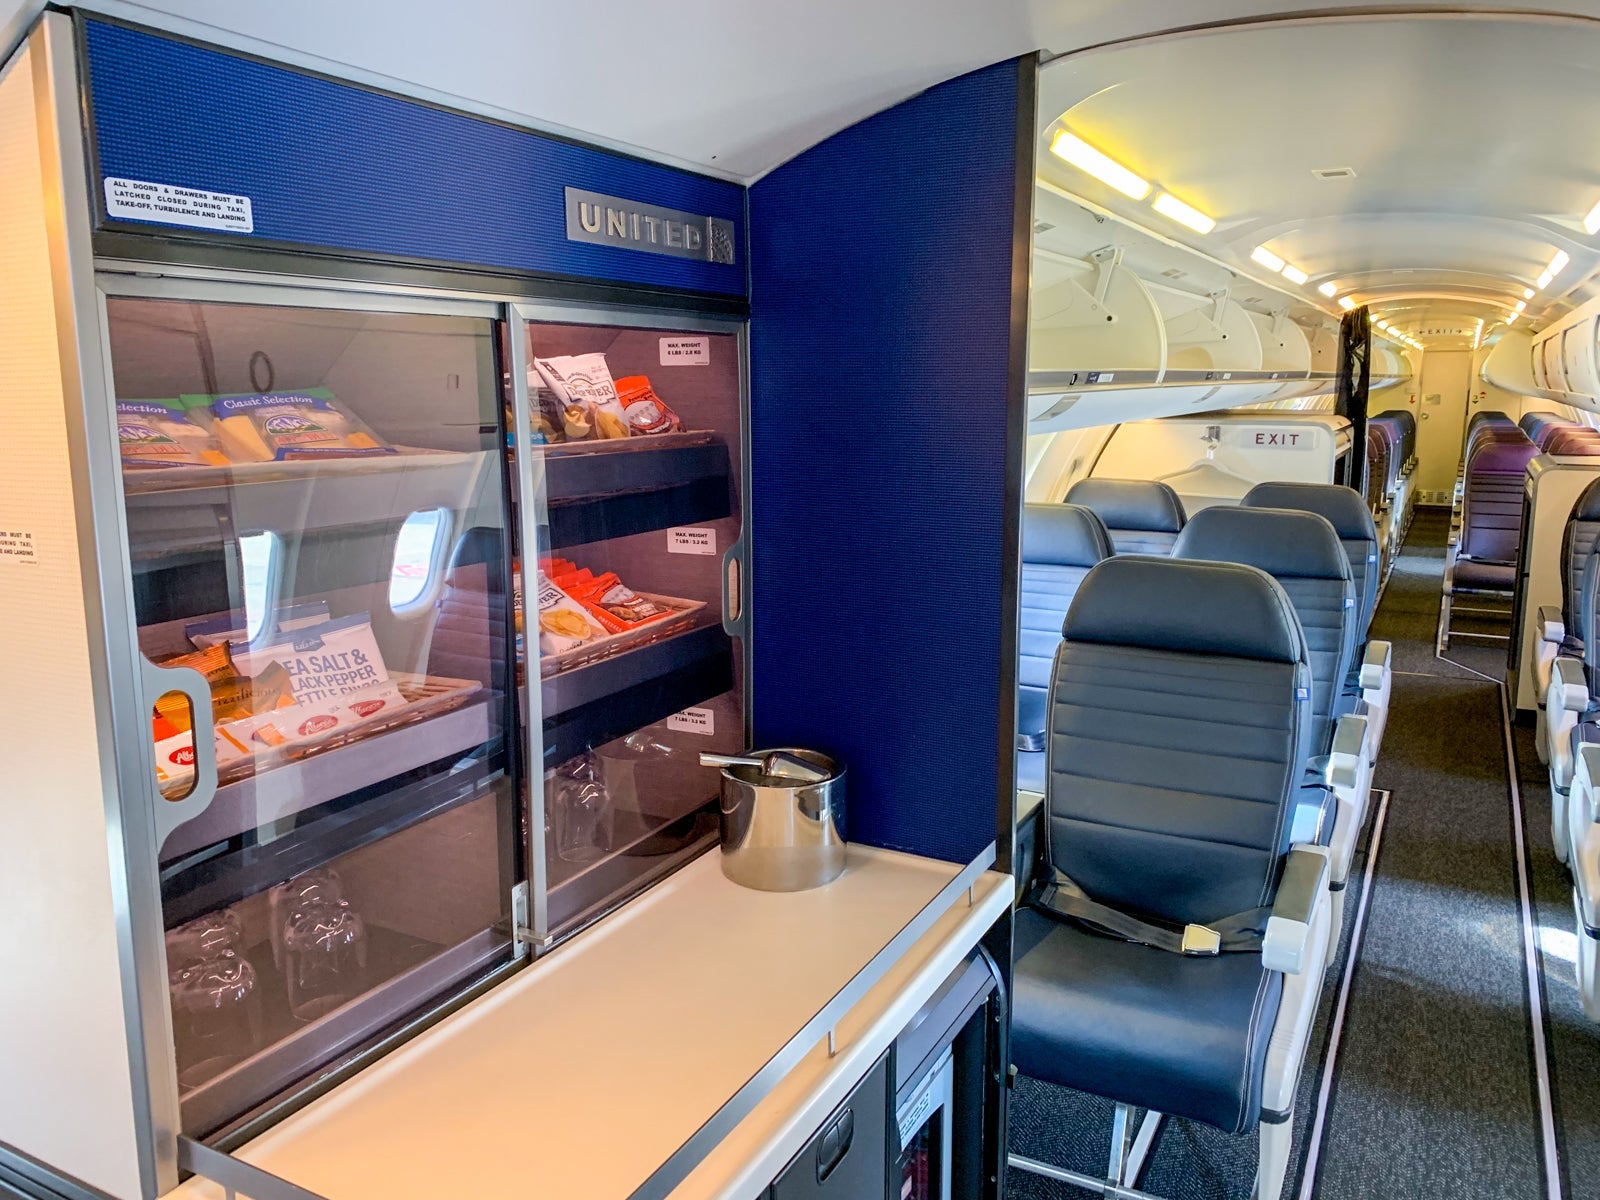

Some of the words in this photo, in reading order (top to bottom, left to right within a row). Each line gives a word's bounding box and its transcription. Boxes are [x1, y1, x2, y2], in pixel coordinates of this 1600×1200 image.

[113, 180, 128, 188] ALL
[133, 183, 158, 192] DOORS
[174, 189, 208, 200] DRAWERS
[212, 195, 231, 203] MUST
[114, 190, 151, 200] LATCHED
[157, 195, 188, 206] CLOSED
[193, 200, 222, 210] DURING
[227, 206, 246, 214] TAXI,
[153, 204, 200, 217] TURBULENCE
[217, 213, 246, 222] LANDING
[578, 201, 701, 250] UNITED
[117, 403, 168, 414] election
[223, 396, 262, 409] Classic
[262, 395, 313, 404] Selection
[1255, 433, 1300, 446] EXIT
[282, 658, 311, 677] EA
[308, 652, 353, 674] SALT
[350, 648, 369, 665] &
[290, 675, 326, 693] LACK
[324, 664, 377, 687] PEPPER
